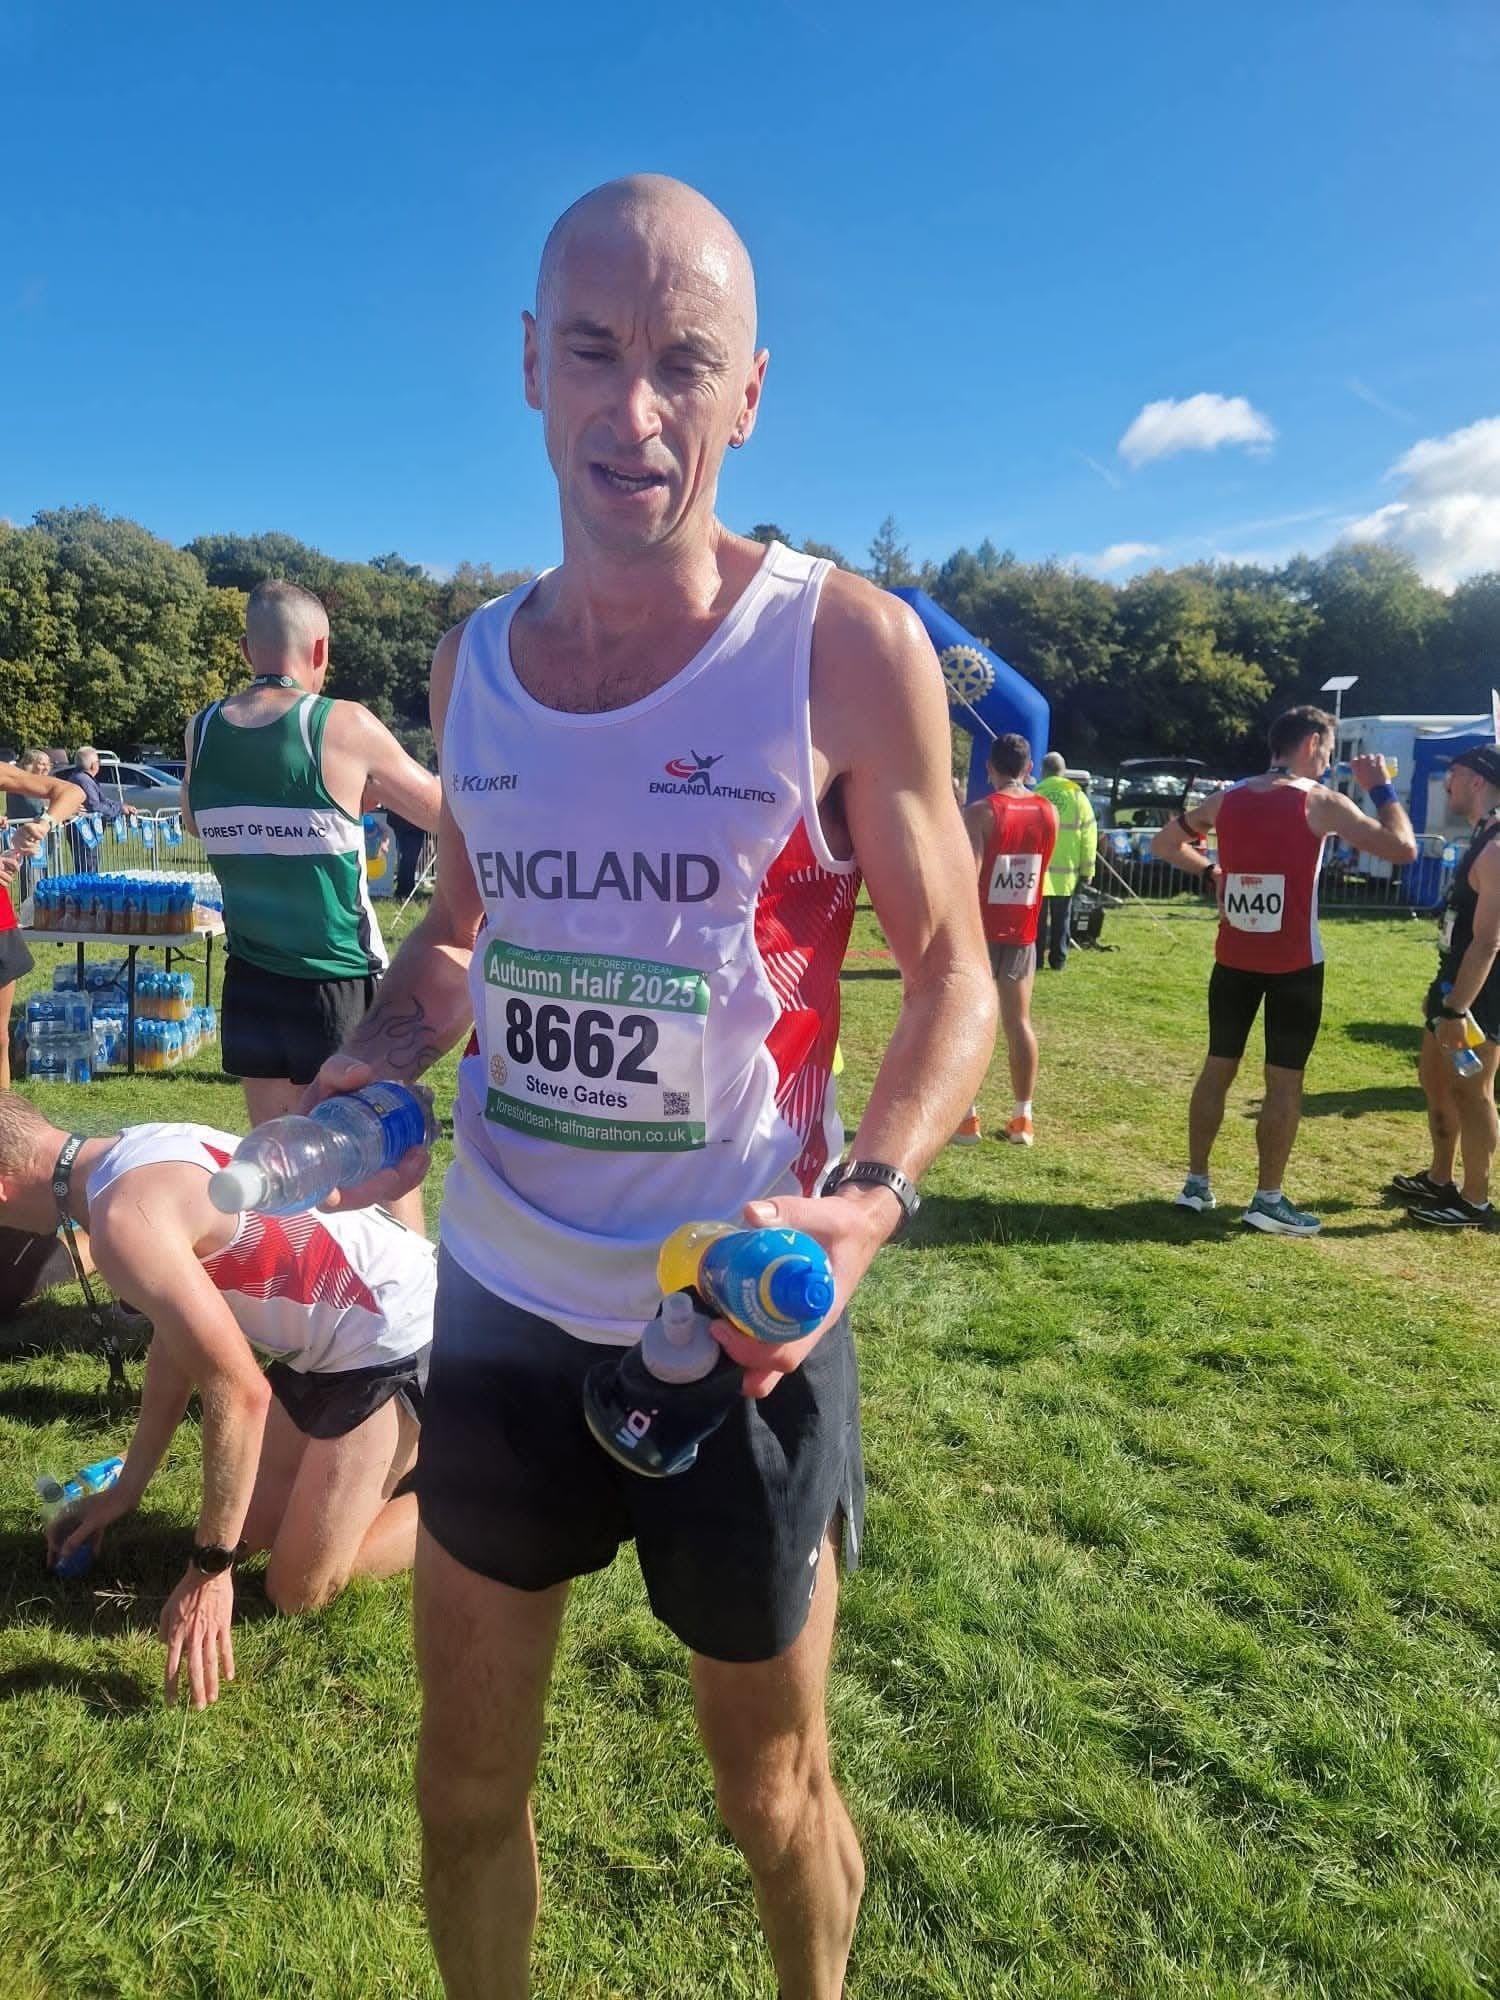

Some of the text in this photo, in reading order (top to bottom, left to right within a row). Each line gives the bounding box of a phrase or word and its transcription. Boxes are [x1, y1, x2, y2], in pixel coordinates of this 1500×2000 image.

[461, 774, 518, 792] KUKRI
[649, 782, 776, 803] ENGLAND ATHLETICS
[202, 823, 328, 838] FOREST OF DEAN AC
[476, 850, 720, 903] ENGLAND
[994, 871, 1037, 889] M35
[1227, 892, 1282, 915] M40
[598, 958, 633, 970] FOREST
[633, 962, 646, 972] OF
[647, 964, 673, 977] DEAN
[488, 954, 697, 1008] Autumn Half 2025
[506, 997, 659, 1085] 8662
[526, 1075, 628, 1109] Steve Gates
[496, 1096, 687, 1143] forestofdean-halfmarathon.co.uk
